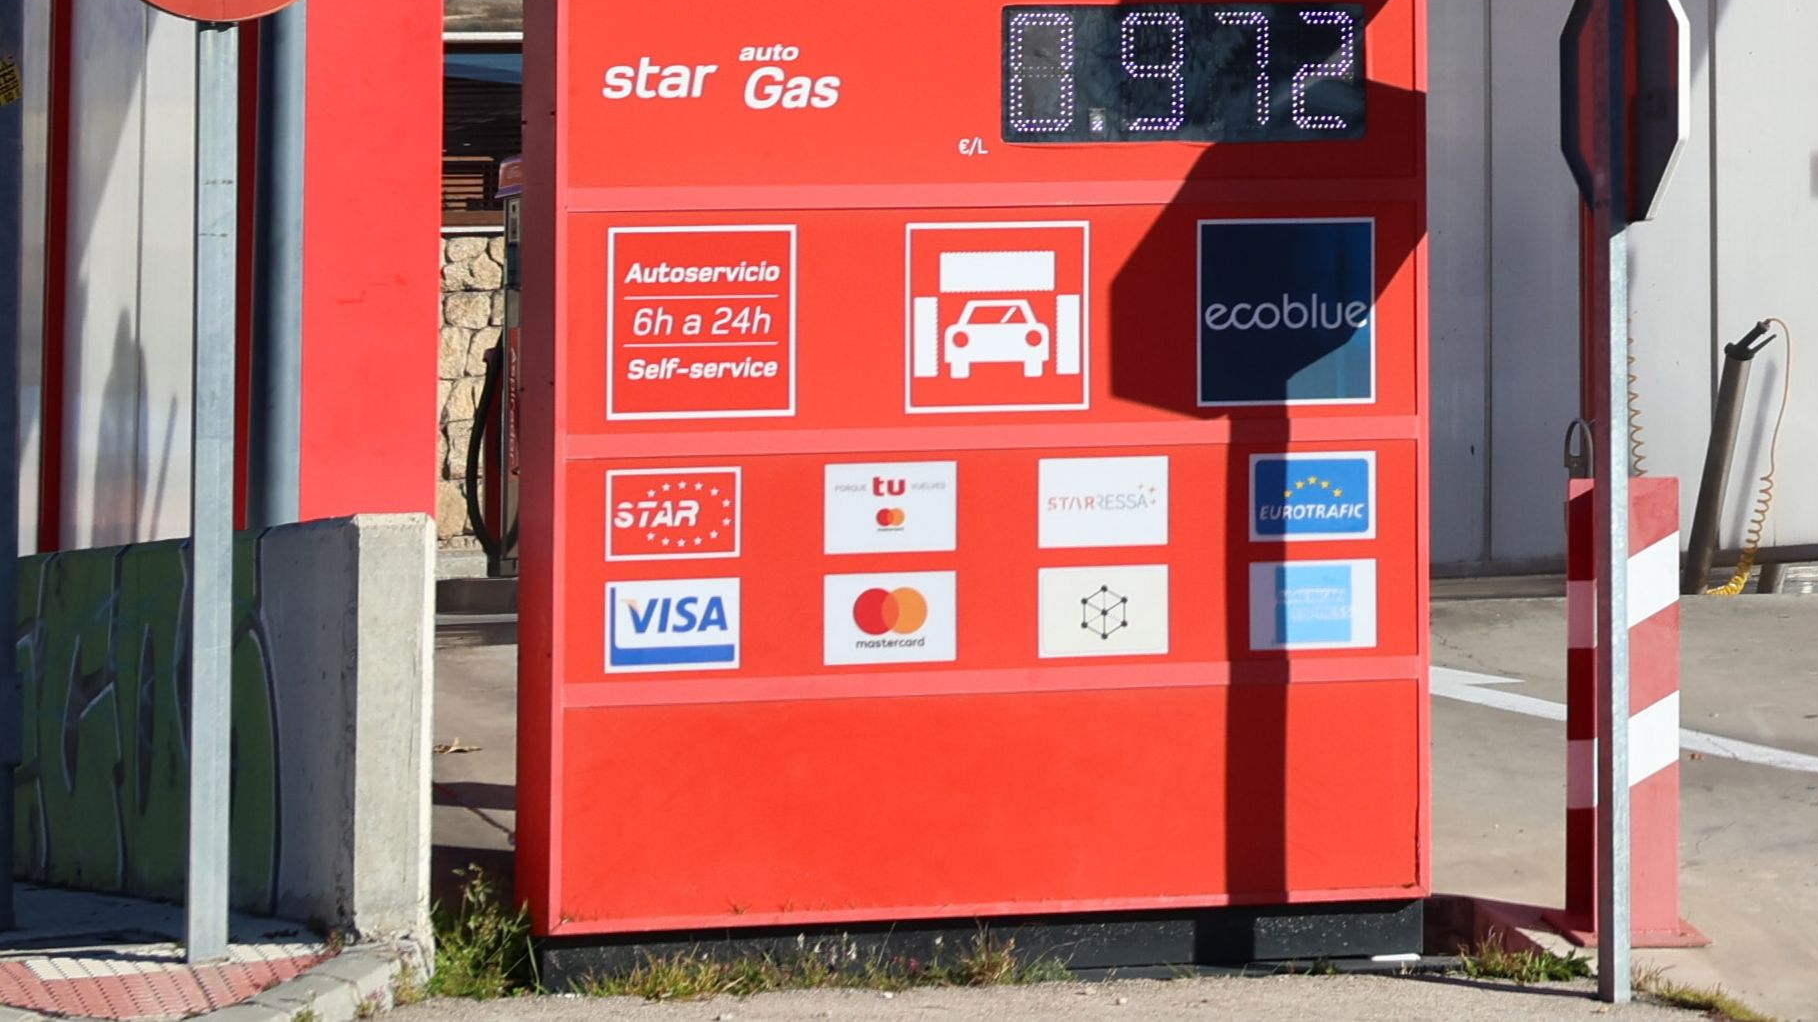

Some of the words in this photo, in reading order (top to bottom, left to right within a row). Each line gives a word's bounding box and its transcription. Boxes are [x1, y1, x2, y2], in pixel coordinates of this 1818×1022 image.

[738, 43, 800, 62] auto
[602, 56, 719, 99] star
[1009, 11, 1355, 133] 0.972
[744, 66, 841, 110] Gas
[958, 136, 989, 156] €/L
[624, 260, 781, 284] Autoservicio
[633, 307, 673, 336] 6h
[682, 314, 702, 336] a
[711, 305, 771, 335] 24h
[1204, 292, 1368, 330] ecoblue
[627, 356, 778, 380] Self-service
[872, 476, 906, 497] tu
[613, 500, 701, 529] STAR
[1259, 503, 1365, 521] EUROTRAFIC
[620, 596, 729, 634] VISA
[855, 637, 926, 649] mastercard
